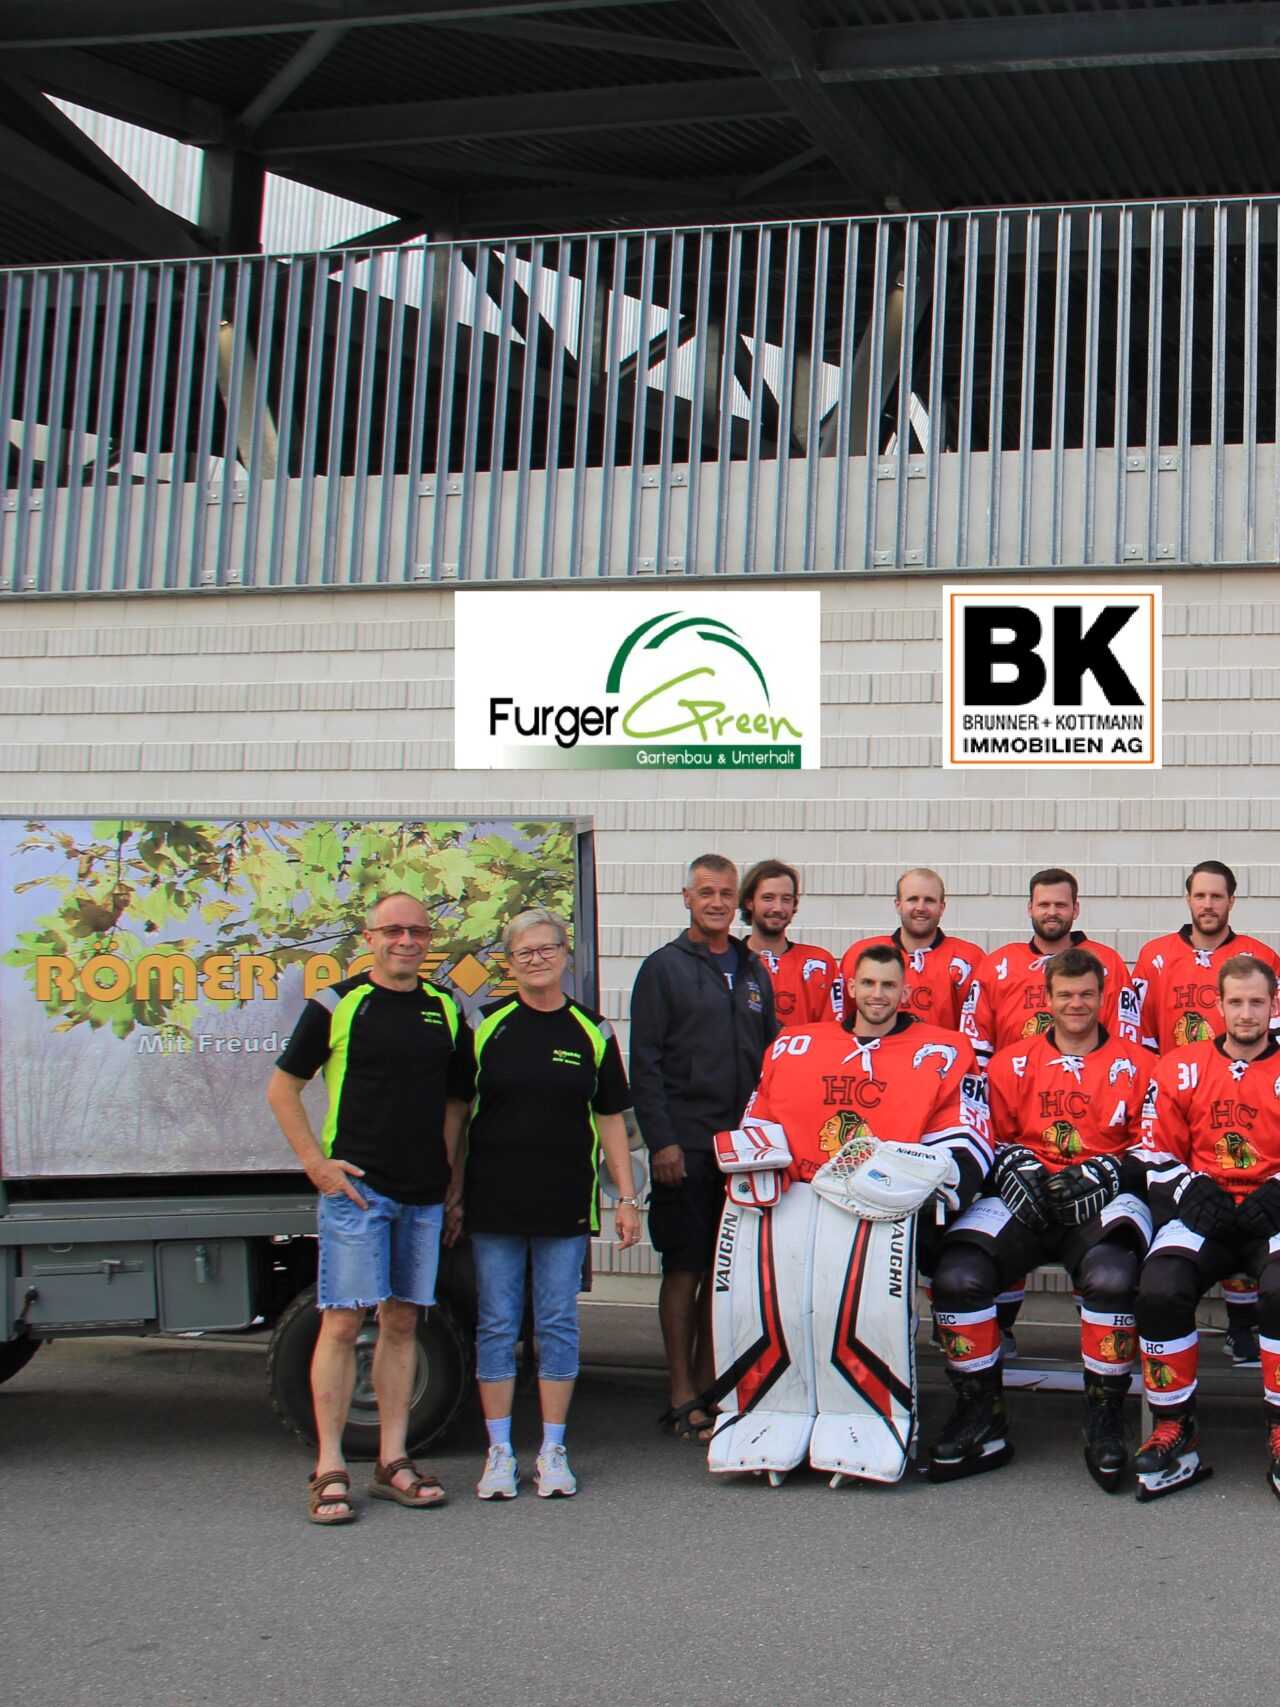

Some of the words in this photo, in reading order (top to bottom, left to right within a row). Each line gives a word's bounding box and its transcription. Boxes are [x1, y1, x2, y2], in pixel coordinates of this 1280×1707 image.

[36, 941, 279, 1001] RÖMER
[1121, 990, 1138, 1014] BK
[1174, 984, 1219, 1009] HC
[138, 1033, 186, 1054] Mit
[1177, 1062, 1198, 1091] 31
[822, 1076, 888, 1108] HC
[962, 1077, 988, 1105] BK
[1039, 1090, 1091, 1119] HC
[1108, 1099, 1126, 1127] A
[1210, 1100, 1257, 1130] HC
[715, 1212, 739, 1292] VAUGHN
[888, 1218, 907, 1299] VAUGHN
[938, 1314, 957, 1325] HC
[1113, 1315, 1134, 1327] HC
[1145, 1342, 1164, 1354] HC
